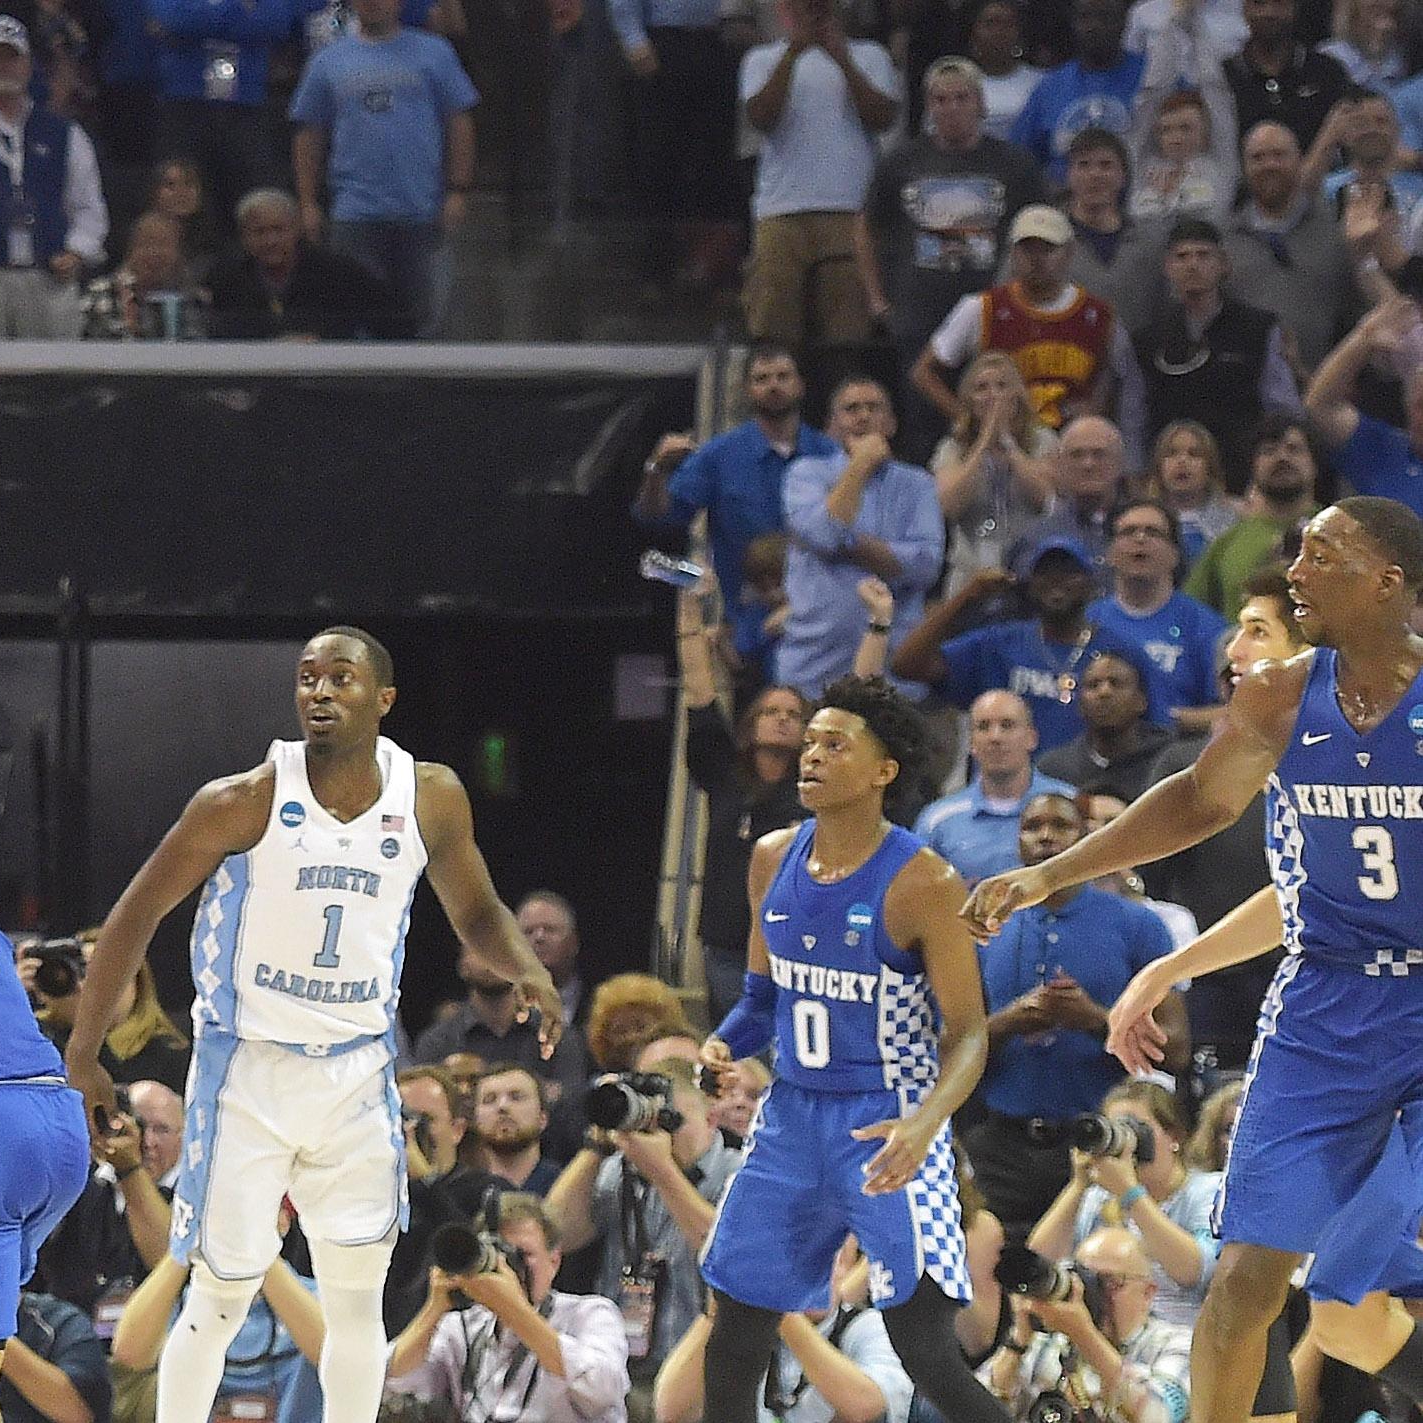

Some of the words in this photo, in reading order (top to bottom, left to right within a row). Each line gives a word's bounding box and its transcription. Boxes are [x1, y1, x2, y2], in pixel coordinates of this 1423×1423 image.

[1293, 783, 1423, 819] KENTUCK
[295, 865, 381, 898] NORTH
[1351, 825, 1400, 901] 3
[313, 904, 344, 968] 1
[254, 963, 380, 1004] CAROLINA
[793, 999, 830, 1070] 0
